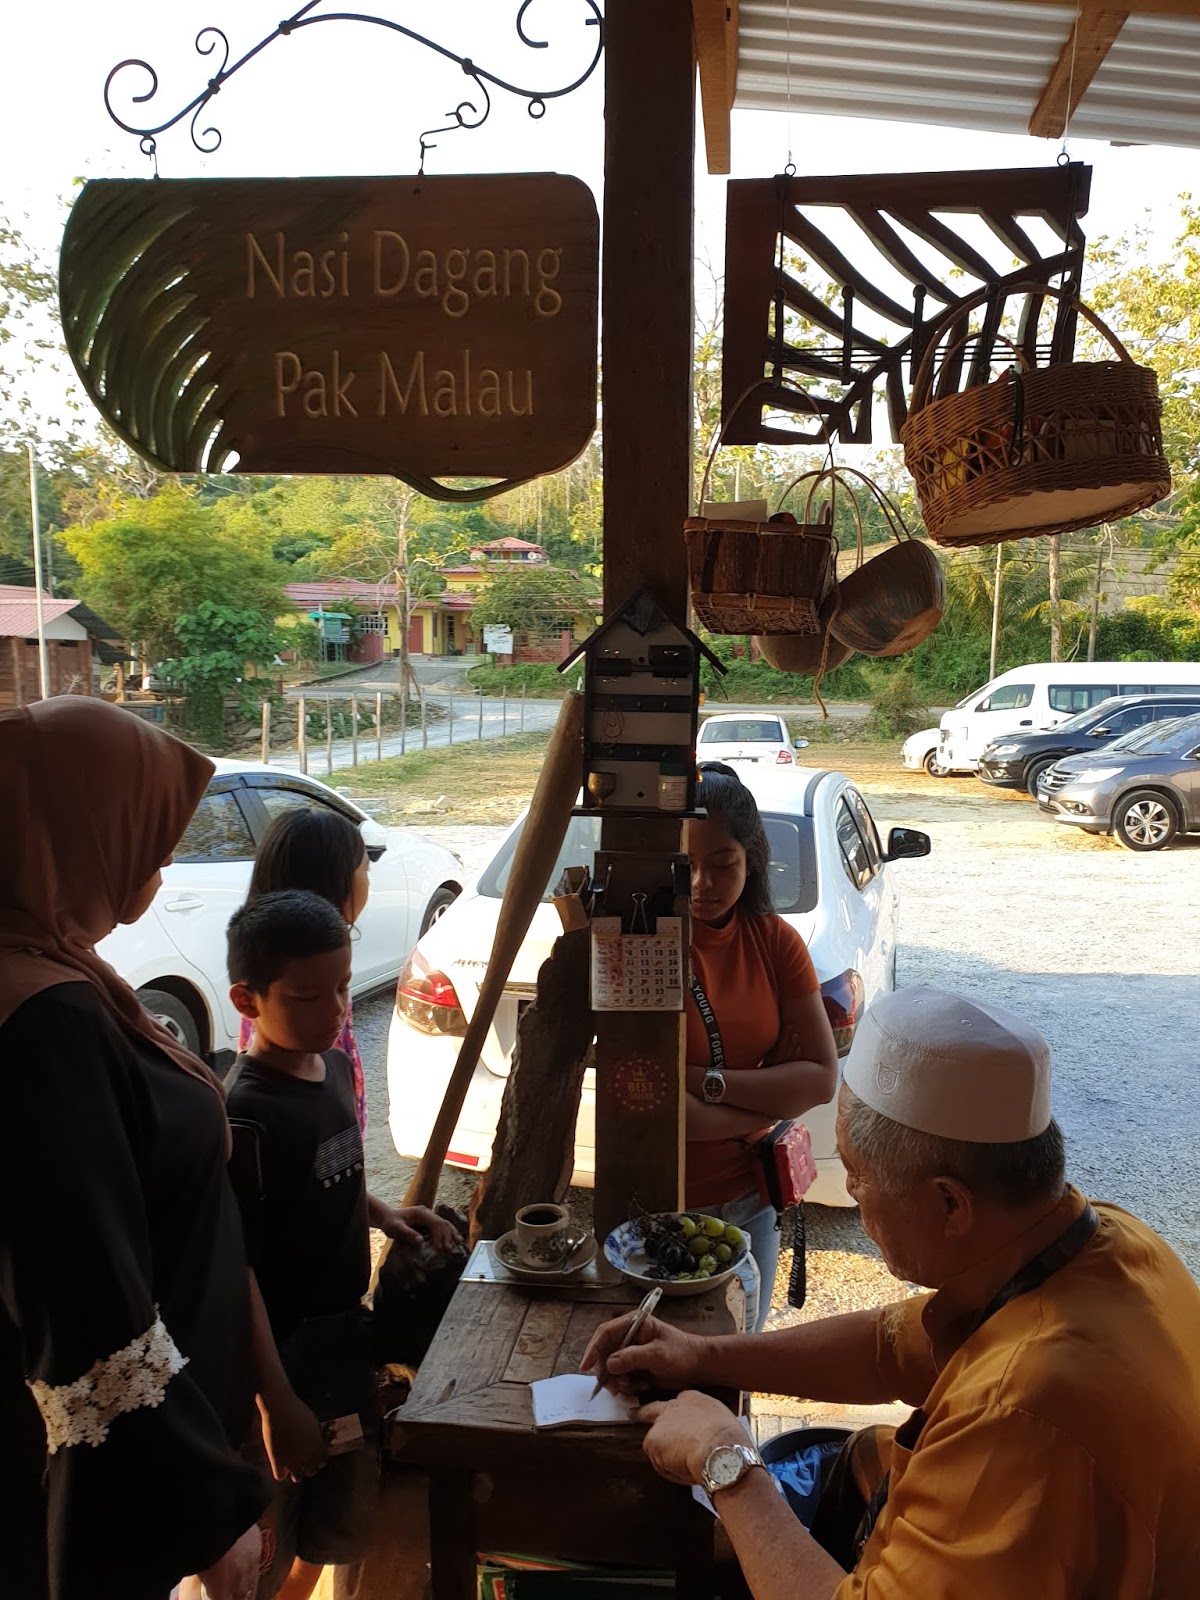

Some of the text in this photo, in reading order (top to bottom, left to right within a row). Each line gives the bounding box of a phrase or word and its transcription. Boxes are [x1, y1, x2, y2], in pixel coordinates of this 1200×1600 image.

[245, 230, 563, 318] Nasi Dagang
[275, 349, 534, 417] Pak Malau
[693, 985, 715, 1024] YOUNG
